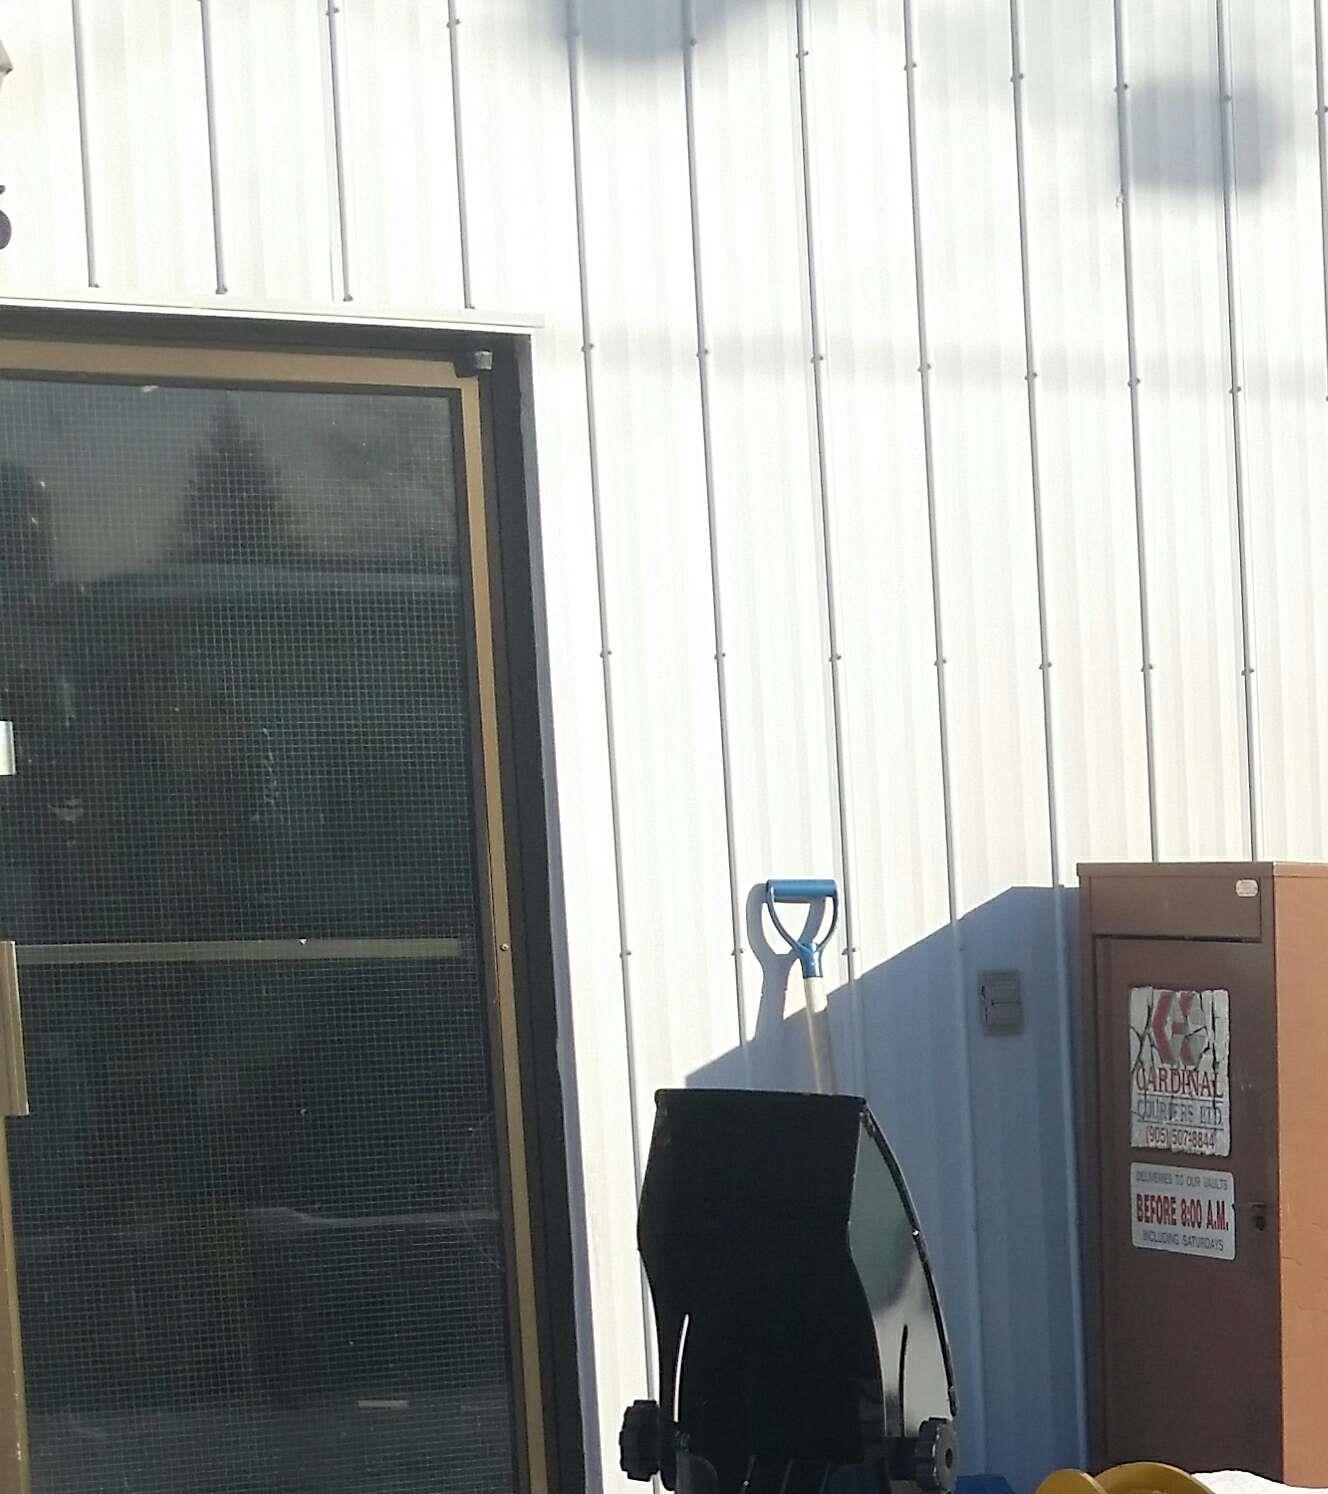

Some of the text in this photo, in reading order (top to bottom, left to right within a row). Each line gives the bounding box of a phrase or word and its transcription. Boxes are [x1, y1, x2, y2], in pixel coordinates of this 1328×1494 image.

[1136, 1066, 1224, 1098] CARDINAL
[1186, 1175, 1201, 1188] OUR
[1136, 1193, 1230, 1231] BEFORE 8:00 A.M.
[1182, 1234, 1225, 1252] SATURDAYS
